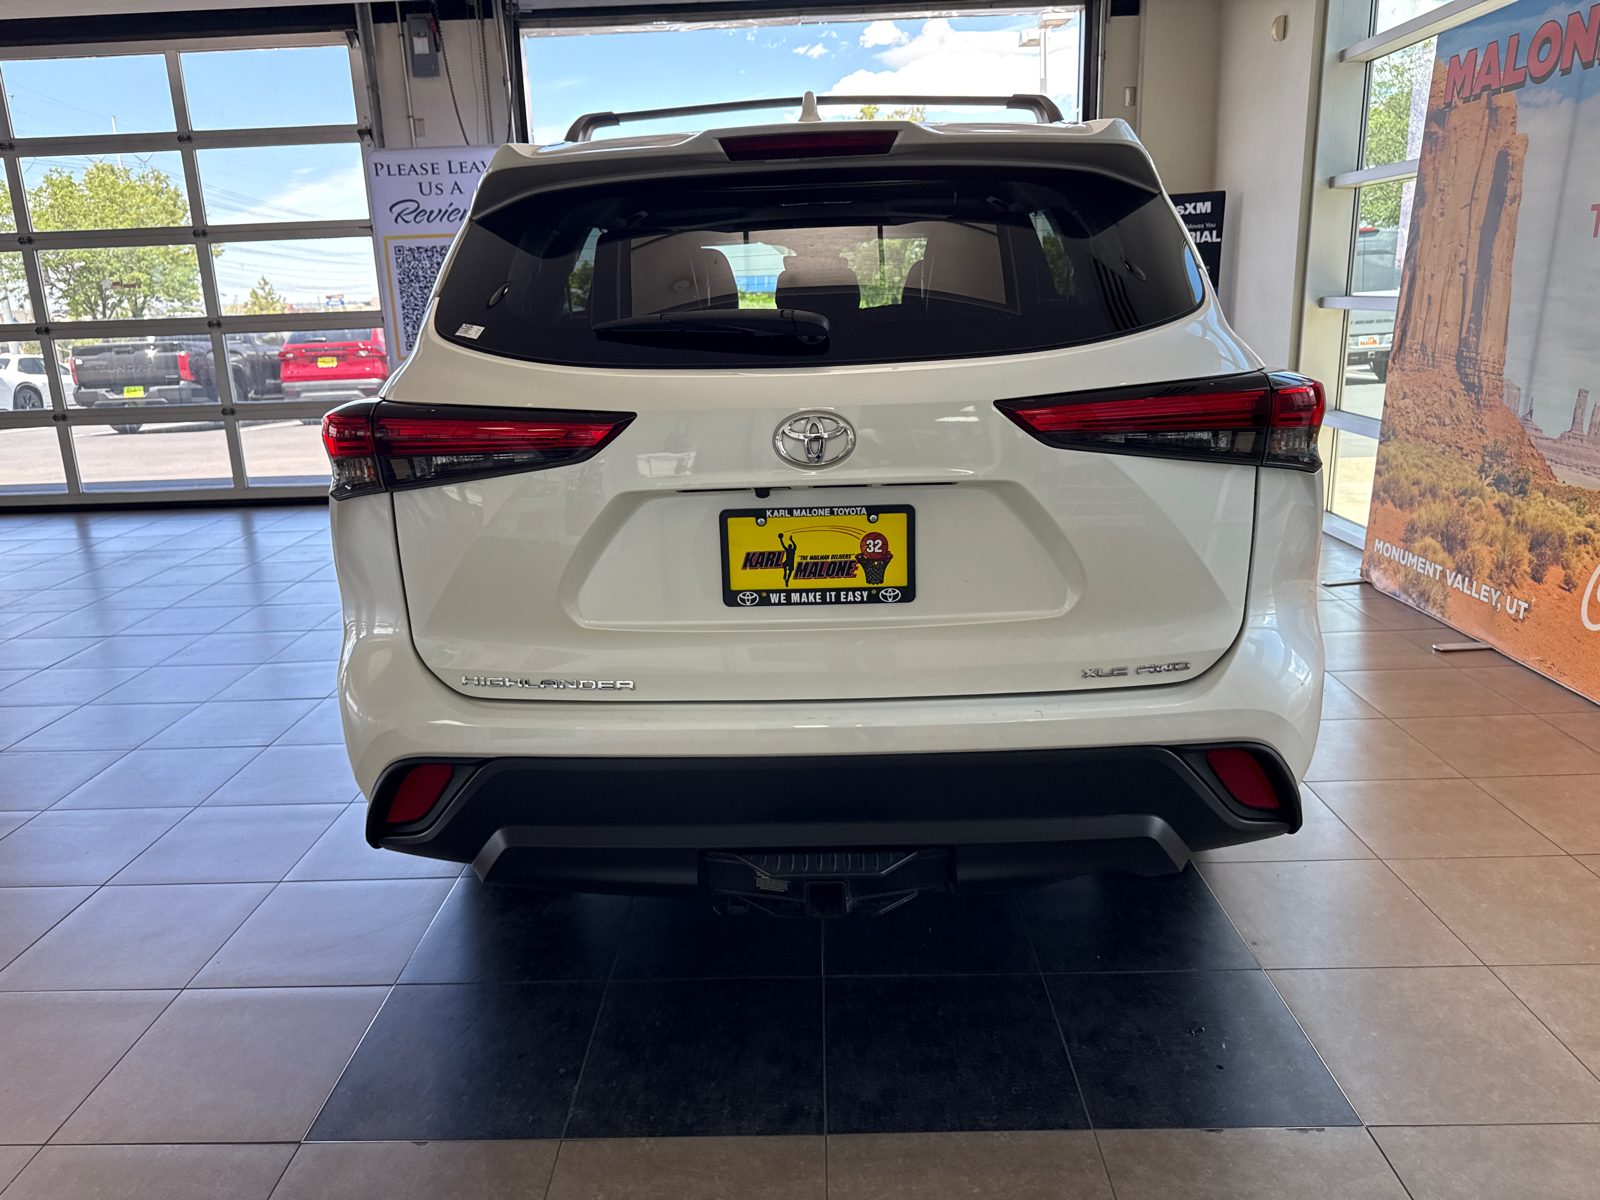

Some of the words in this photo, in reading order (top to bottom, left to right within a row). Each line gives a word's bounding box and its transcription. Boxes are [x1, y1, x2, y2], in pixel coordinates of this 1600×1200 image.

[1443, 3, 1600, 109] MALON
[373, 162, 440, 177] PLEASE
[418, 181, 444, 196] US
[450, 180, 465, 195] A
[766, 509, 791, 518] KARL
[793, 508, 831, 517] MALONE
[833, 507, 867, 516] TOYOTA
[866, 539, 883, 553] 32
[742, 551, 785, 570] KARL
[793, 560, 858, 580] MALONE
[1374, 539, 1443, 581] MONUMENT
[1445, 569, 1501, 612] VALLEY,
[1505, 595, 1529, 620] UT
[770, 592, 787, 604] WE
[791, 592, 822, 603] MAKE
[826, 591, 836, 602] IT
[840, 590, 868, 602] EASY
[1081, 667, 1128, 678] XLE
[1136, 662, 1190, 674] AWD
[461, 675, 636, 691] HIGHLANDER
